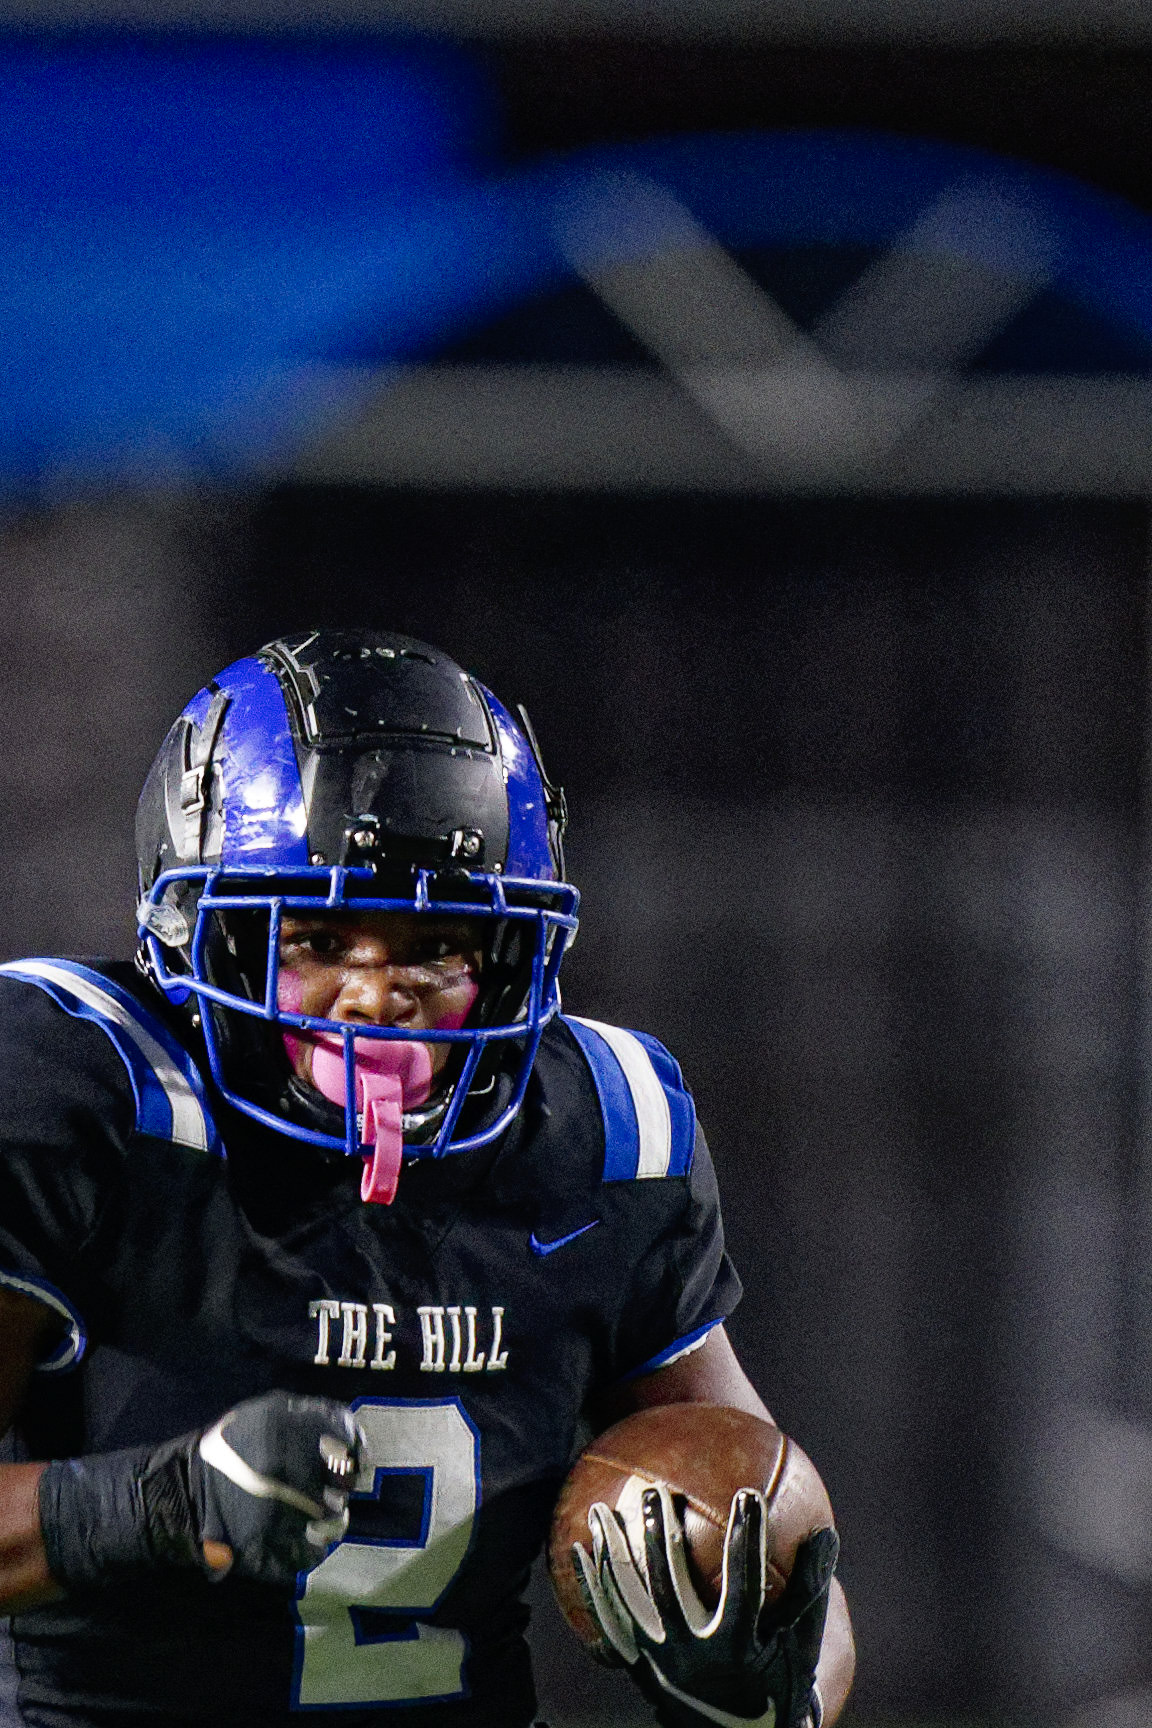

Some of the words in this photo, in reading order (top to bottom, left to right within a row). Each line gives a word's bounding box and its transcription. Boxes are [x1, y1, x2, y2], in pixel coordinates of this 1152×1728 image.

[309, 1300, 396, 1370] THE
[417, 1306, 509, 1372] HILL
[291, 1396, 482, 1711] 2
